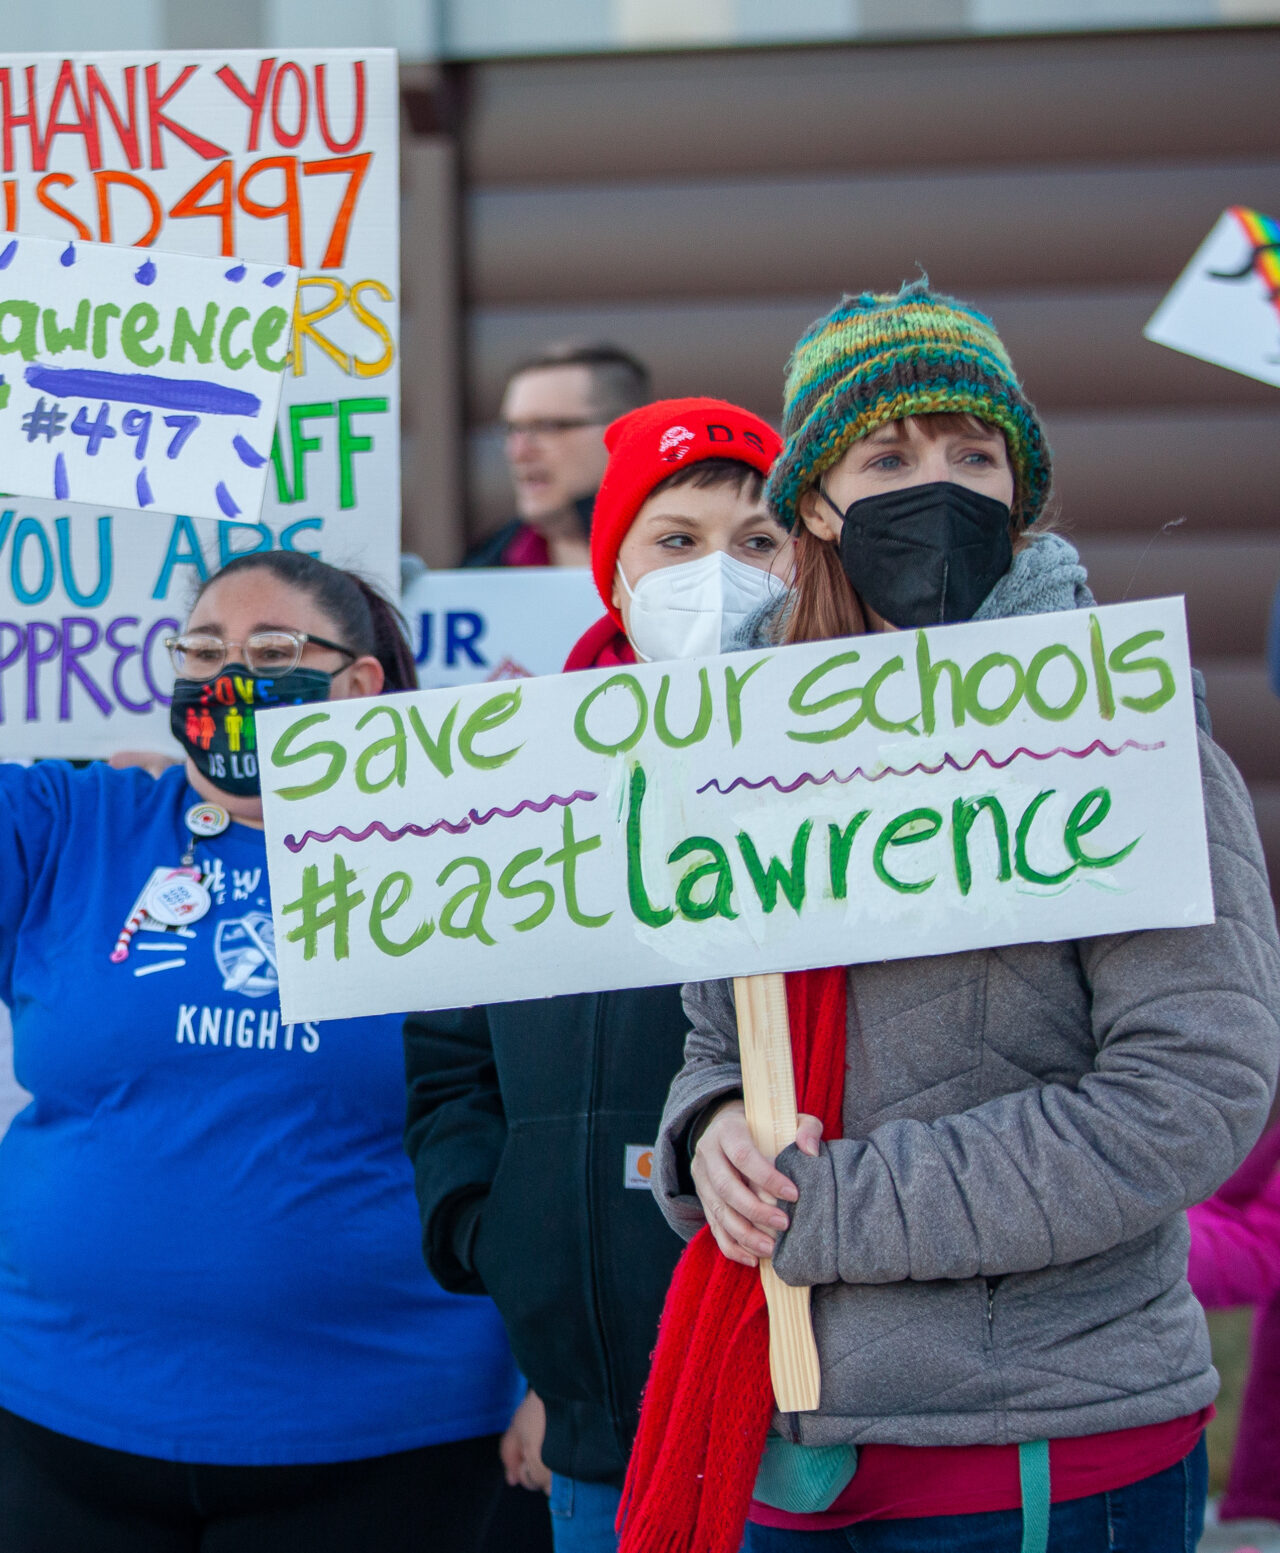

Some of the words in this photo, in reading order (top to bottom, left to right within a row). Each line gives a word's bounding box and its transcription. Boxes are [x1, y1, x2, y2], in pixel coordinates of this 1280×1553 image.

[214, 58, 367, 155] YOU
[21, 396, 201, 459] #497
[271, 685, 523, 800] save
[574, 656, 775, 756] our
[787, 613, 1175, 744] schools
[230, 753, 258, 779] LO
